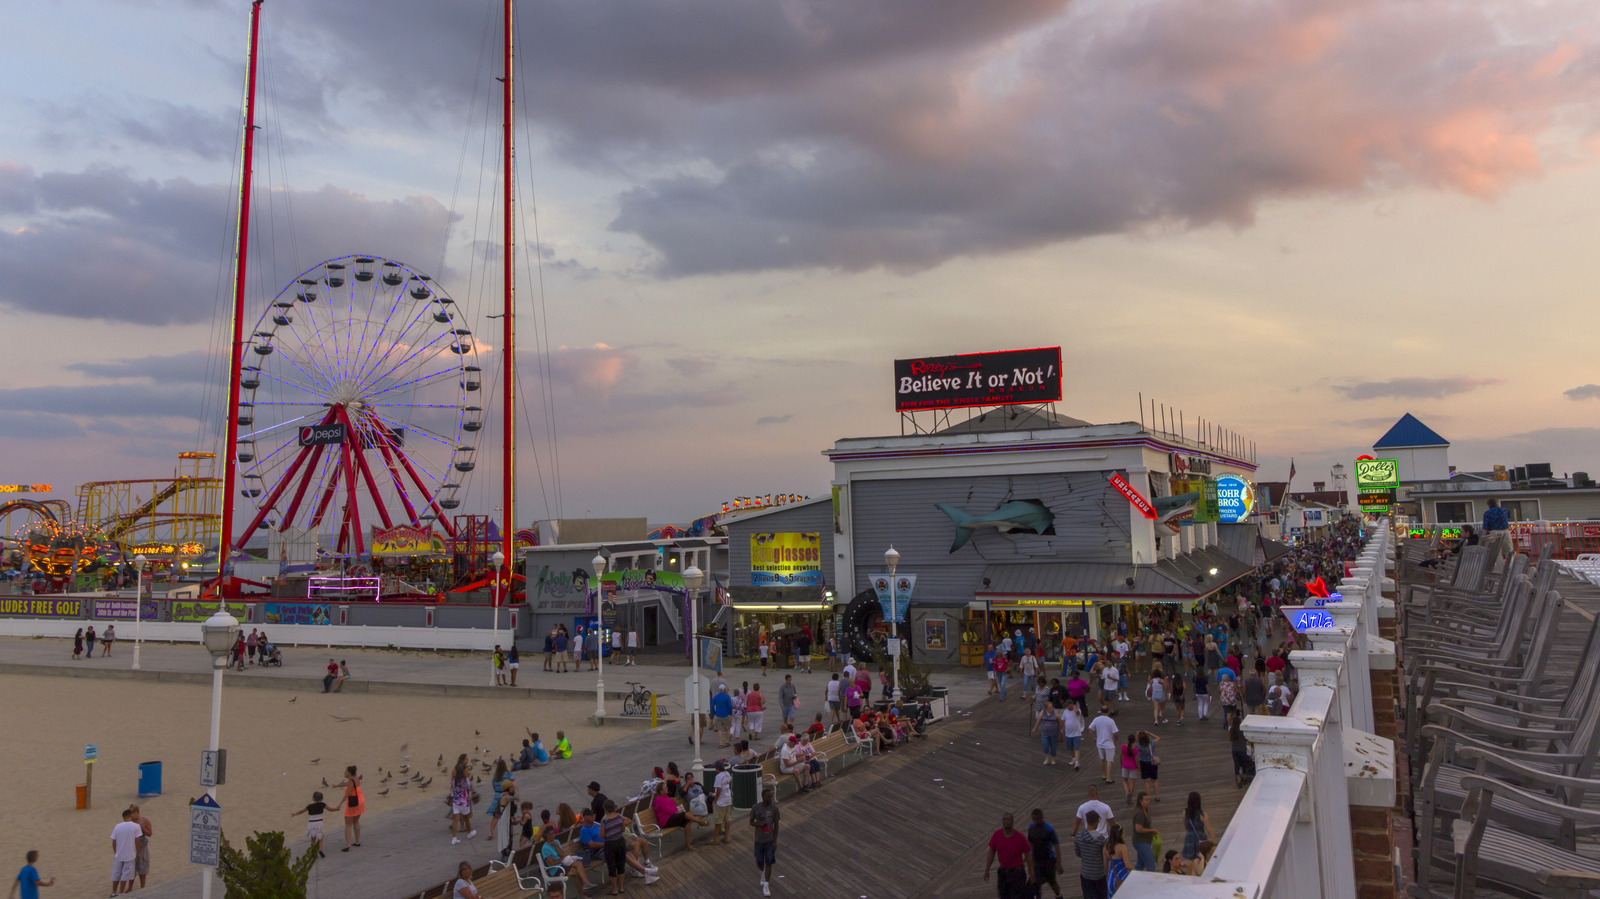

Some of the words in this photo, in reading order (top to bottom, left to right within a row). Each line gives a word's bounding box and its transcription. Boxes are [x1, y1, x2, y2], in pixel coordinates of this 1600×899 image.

[898, 375, 961, 394] Believe
[966, 371, 983, 389] It
[988, 373, 1009, 388] or
[315, 427, 342, 440] pepsi
[1358, 461, 1395, 477] Dolle's
[31, 484, 52, 493] STAR
[1113, 477, 1150, 512] ENTRANCE
[1217, 489, 1240, 498] KOHR
[1218, 498, 1240, 507] BROS
[752, 545, 819, 564] Sunglasses
[753, 573, 758, 582] 2
[0, 600, 28, 614] LUDES
[30, 600, 53, 614] FREE
[56, 601, 80, 615] GOLF
